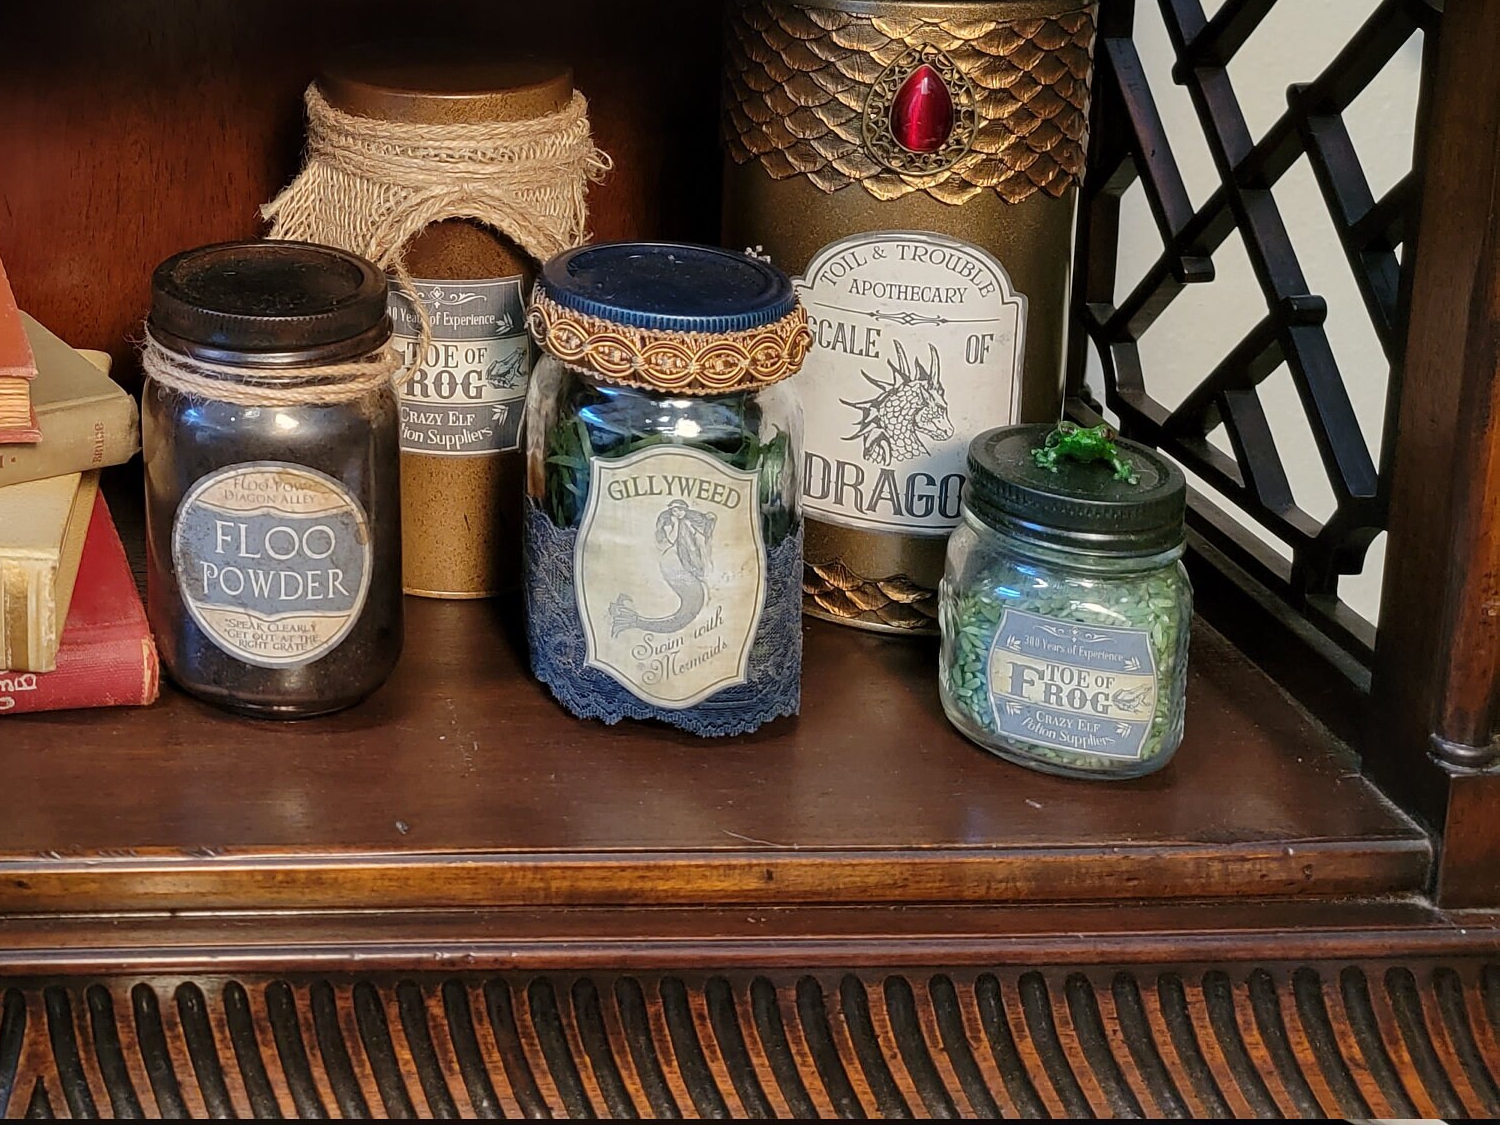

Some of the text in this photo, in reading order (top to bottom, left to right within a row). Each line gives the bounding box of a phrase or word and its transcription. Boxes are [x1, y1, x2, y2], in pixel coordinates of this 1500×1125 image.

[820, 244, 996, 299] TOIL & TROUBLE
[848, 278, 968, 304] APOTHECARY
[430, 312, 496, 330] of Experience
[464, 348, 487, 364] OF
[965, 333, 994, 365] OF
[401, 407, 475, 426] CRAZY ELF
[427, 426, 493, 449] Suppliers
[607, 475, 741, 509] GILLYWEED
[803, 451, 967, 519] DRAGO
[215, 520, 336, 560] FLOO
[200, 560, 349, 600] POWDER
[254, 632, 275, 641] OUT
[267, 624, 316, 633] CLEARLY
[631, 605, 724, 661] Swim with
[238, 640, 308, 652] RIGHT GRATE
[641, 636, 728, 685] Mermaids
[1006, 661, 1113, 715] FROG
[1045, 663, 1115, 689] TOE OF
[1036, 710, 1101, 732] CRAZY ELF
